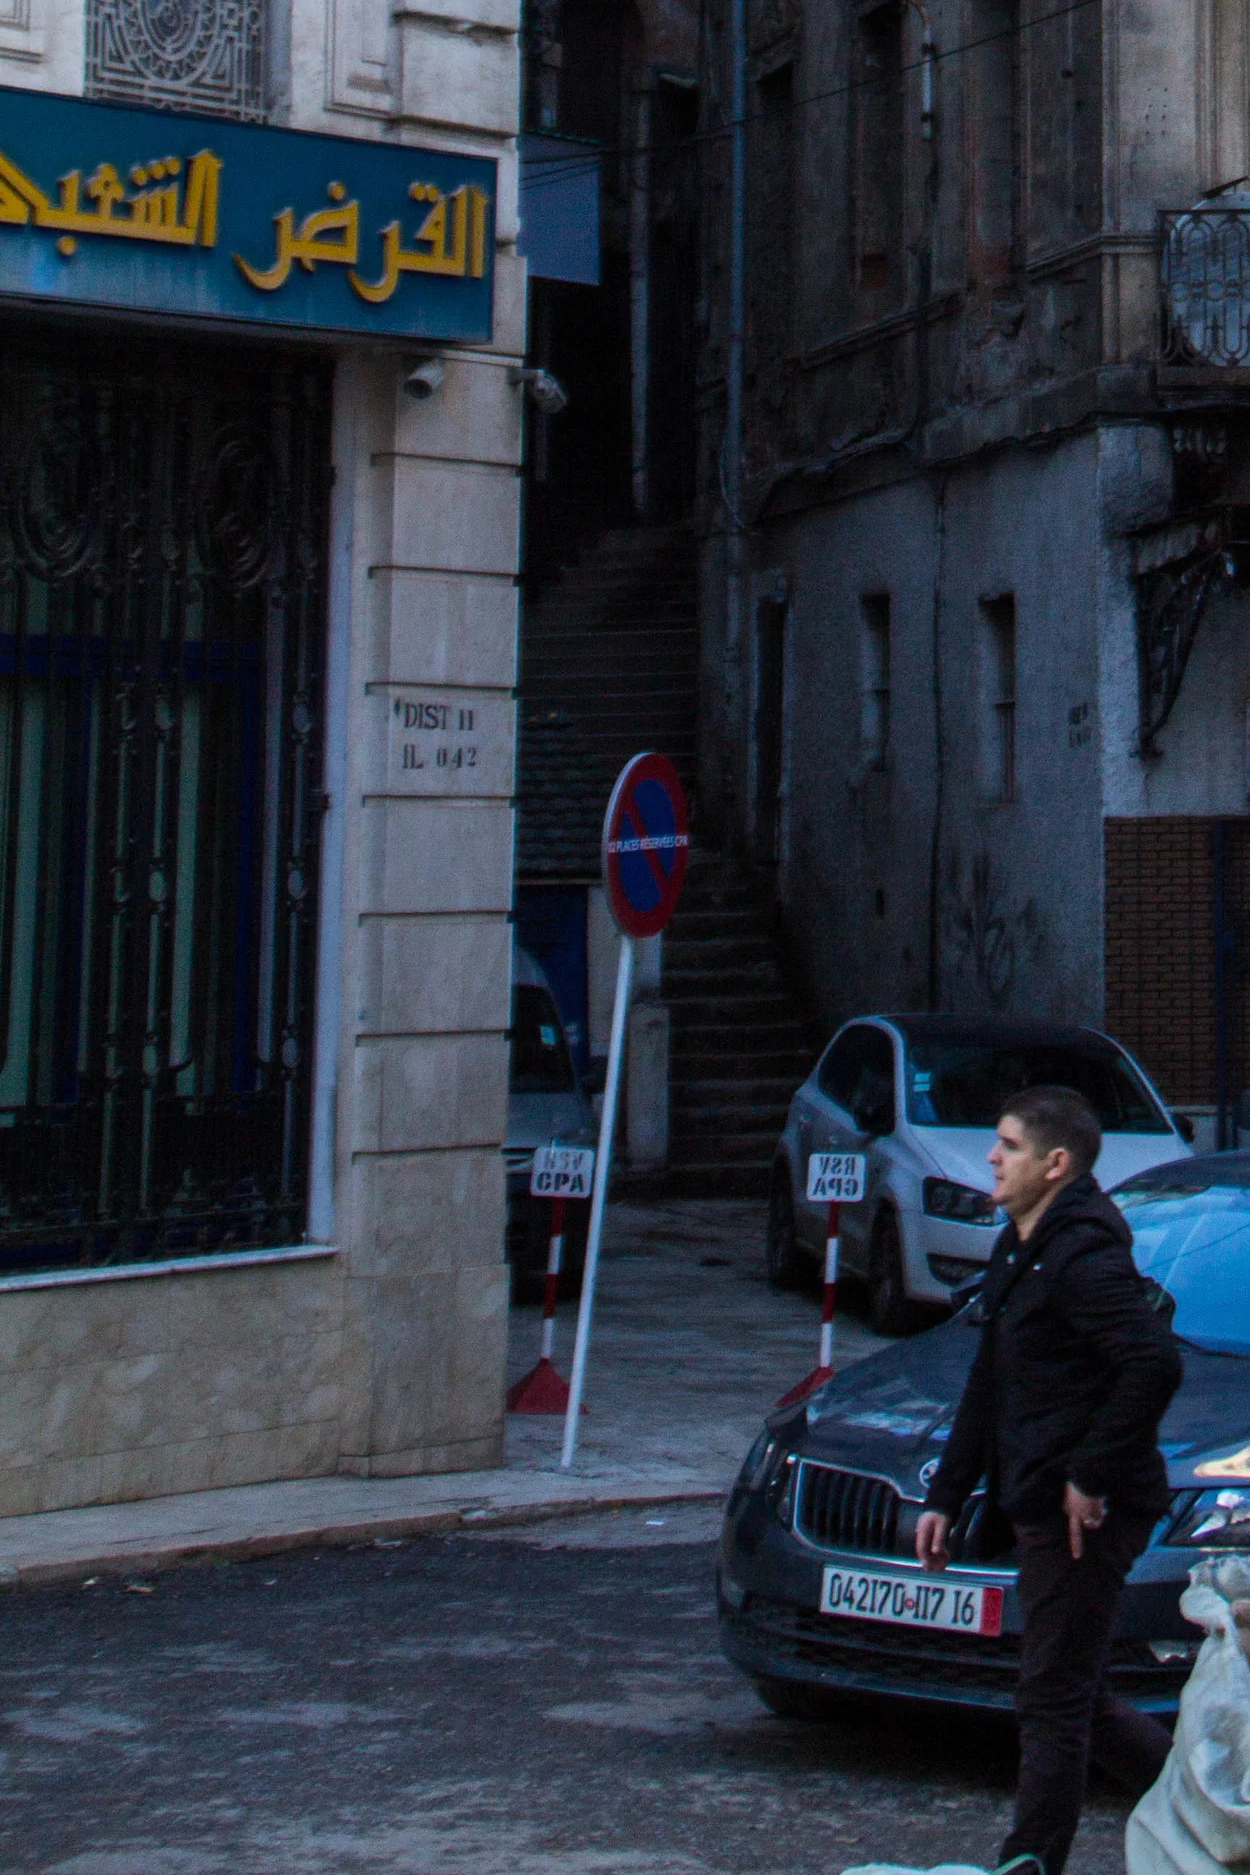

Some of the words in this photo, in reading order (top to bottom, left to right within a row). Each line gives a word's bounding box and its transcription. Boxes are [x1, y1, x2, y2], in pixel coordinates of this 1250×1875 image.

[233, 181, 489, 303] القرض
[404, 703, 449, 730] DIST
[828, 1573, 905, 1617] 042170
[951, 1589, 975, 1625] 16
